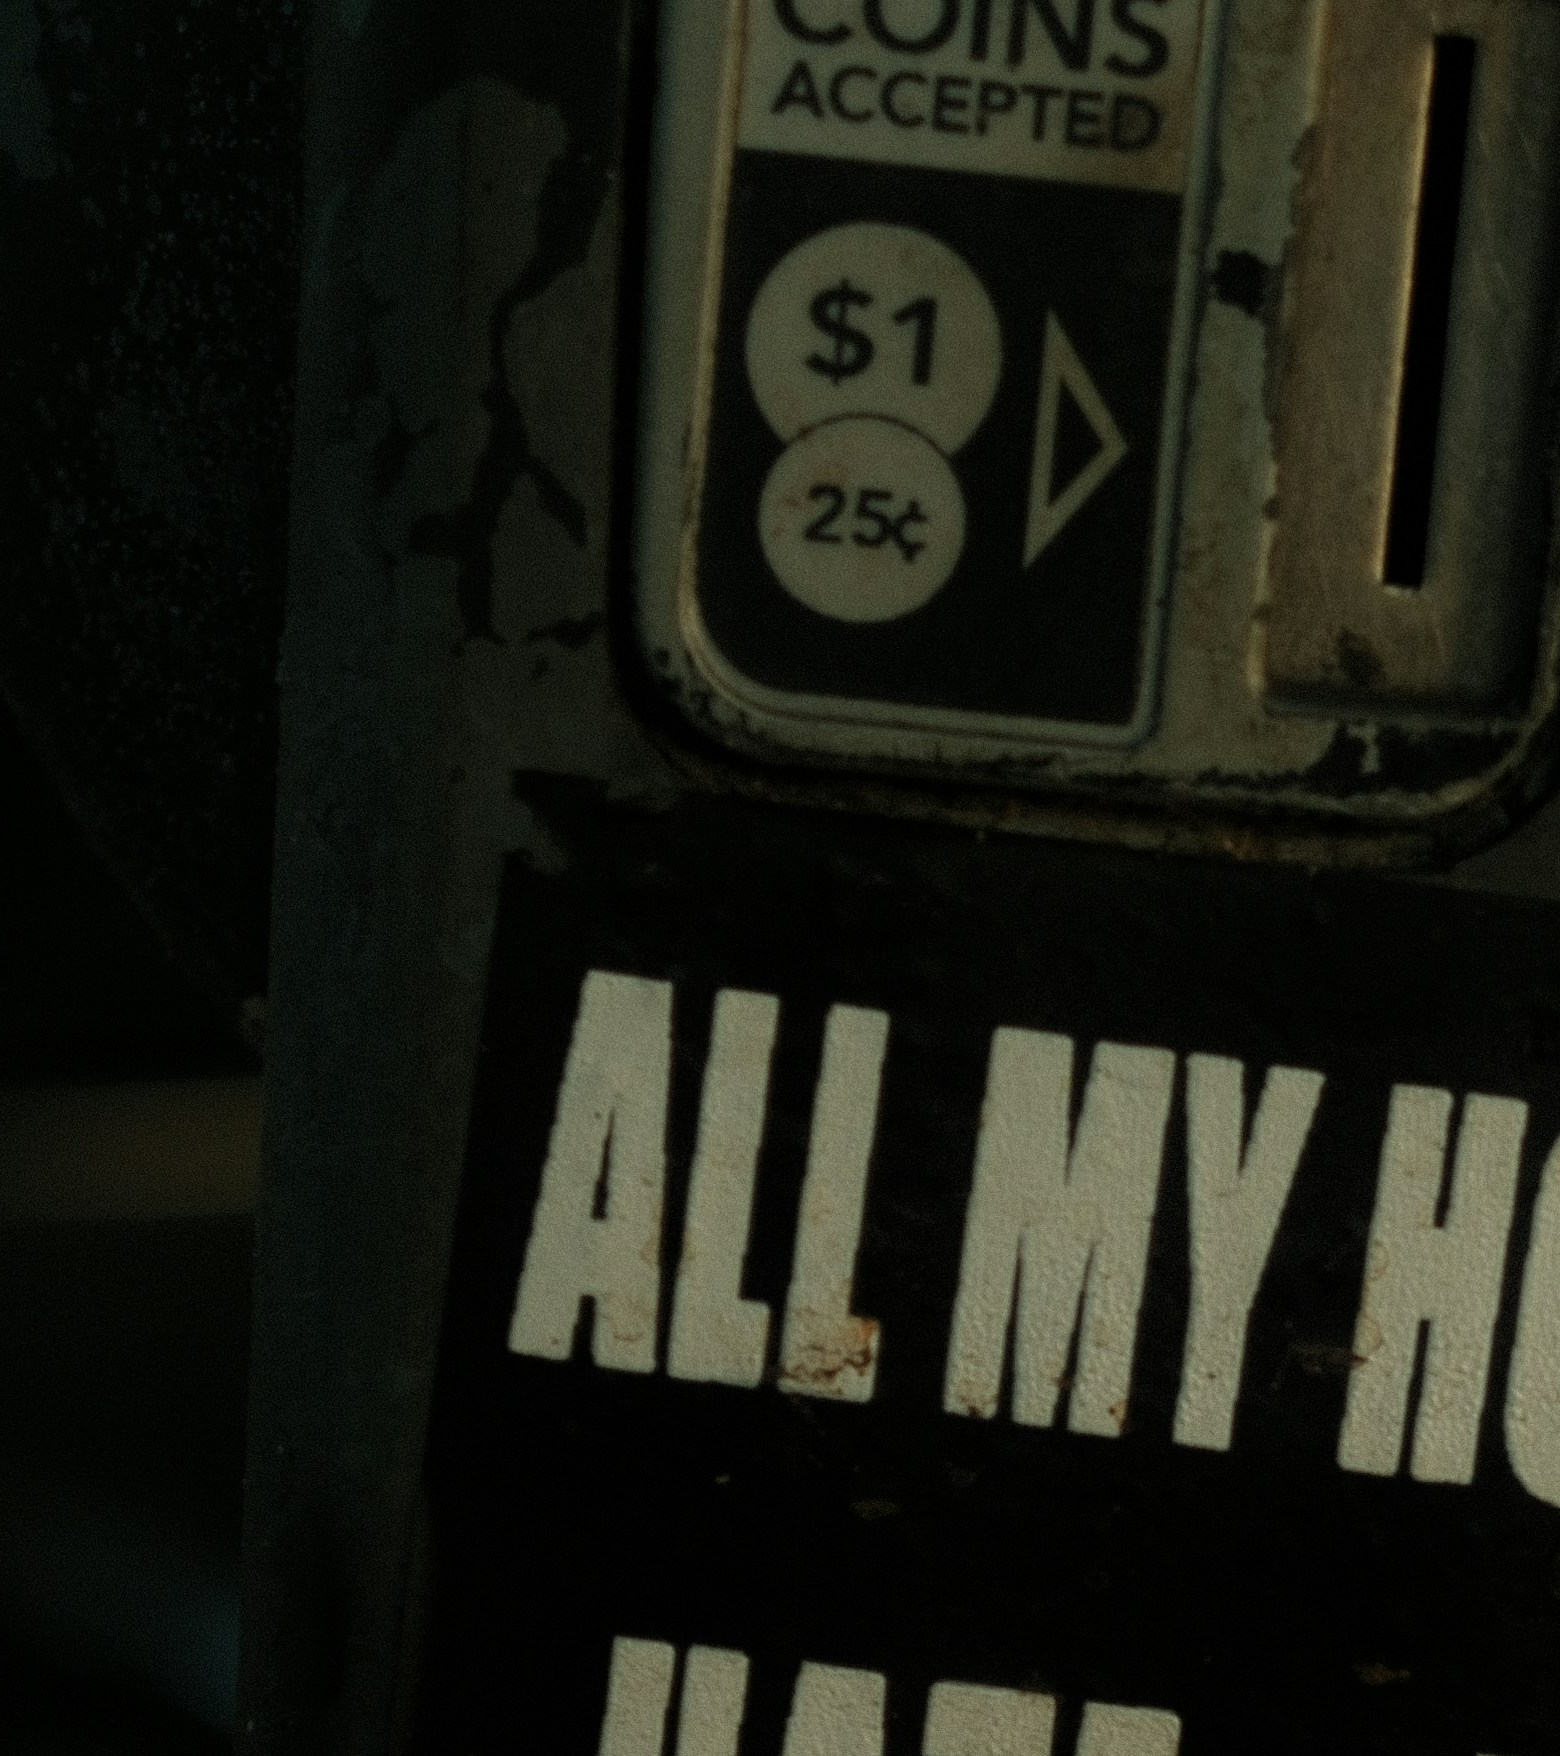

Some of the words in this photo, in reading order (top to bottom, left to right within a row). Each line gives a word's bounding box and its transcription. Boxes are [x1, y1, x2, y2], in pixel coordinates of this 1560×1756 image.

[772, 61, 1160, 151] ACCEPTED
[804, 280, 938, 386] $1
[802, 482, 930, 563] 25¢
[507, 967, 890, 1404] ALL
[943, 1025, 1326, 1453] MY
